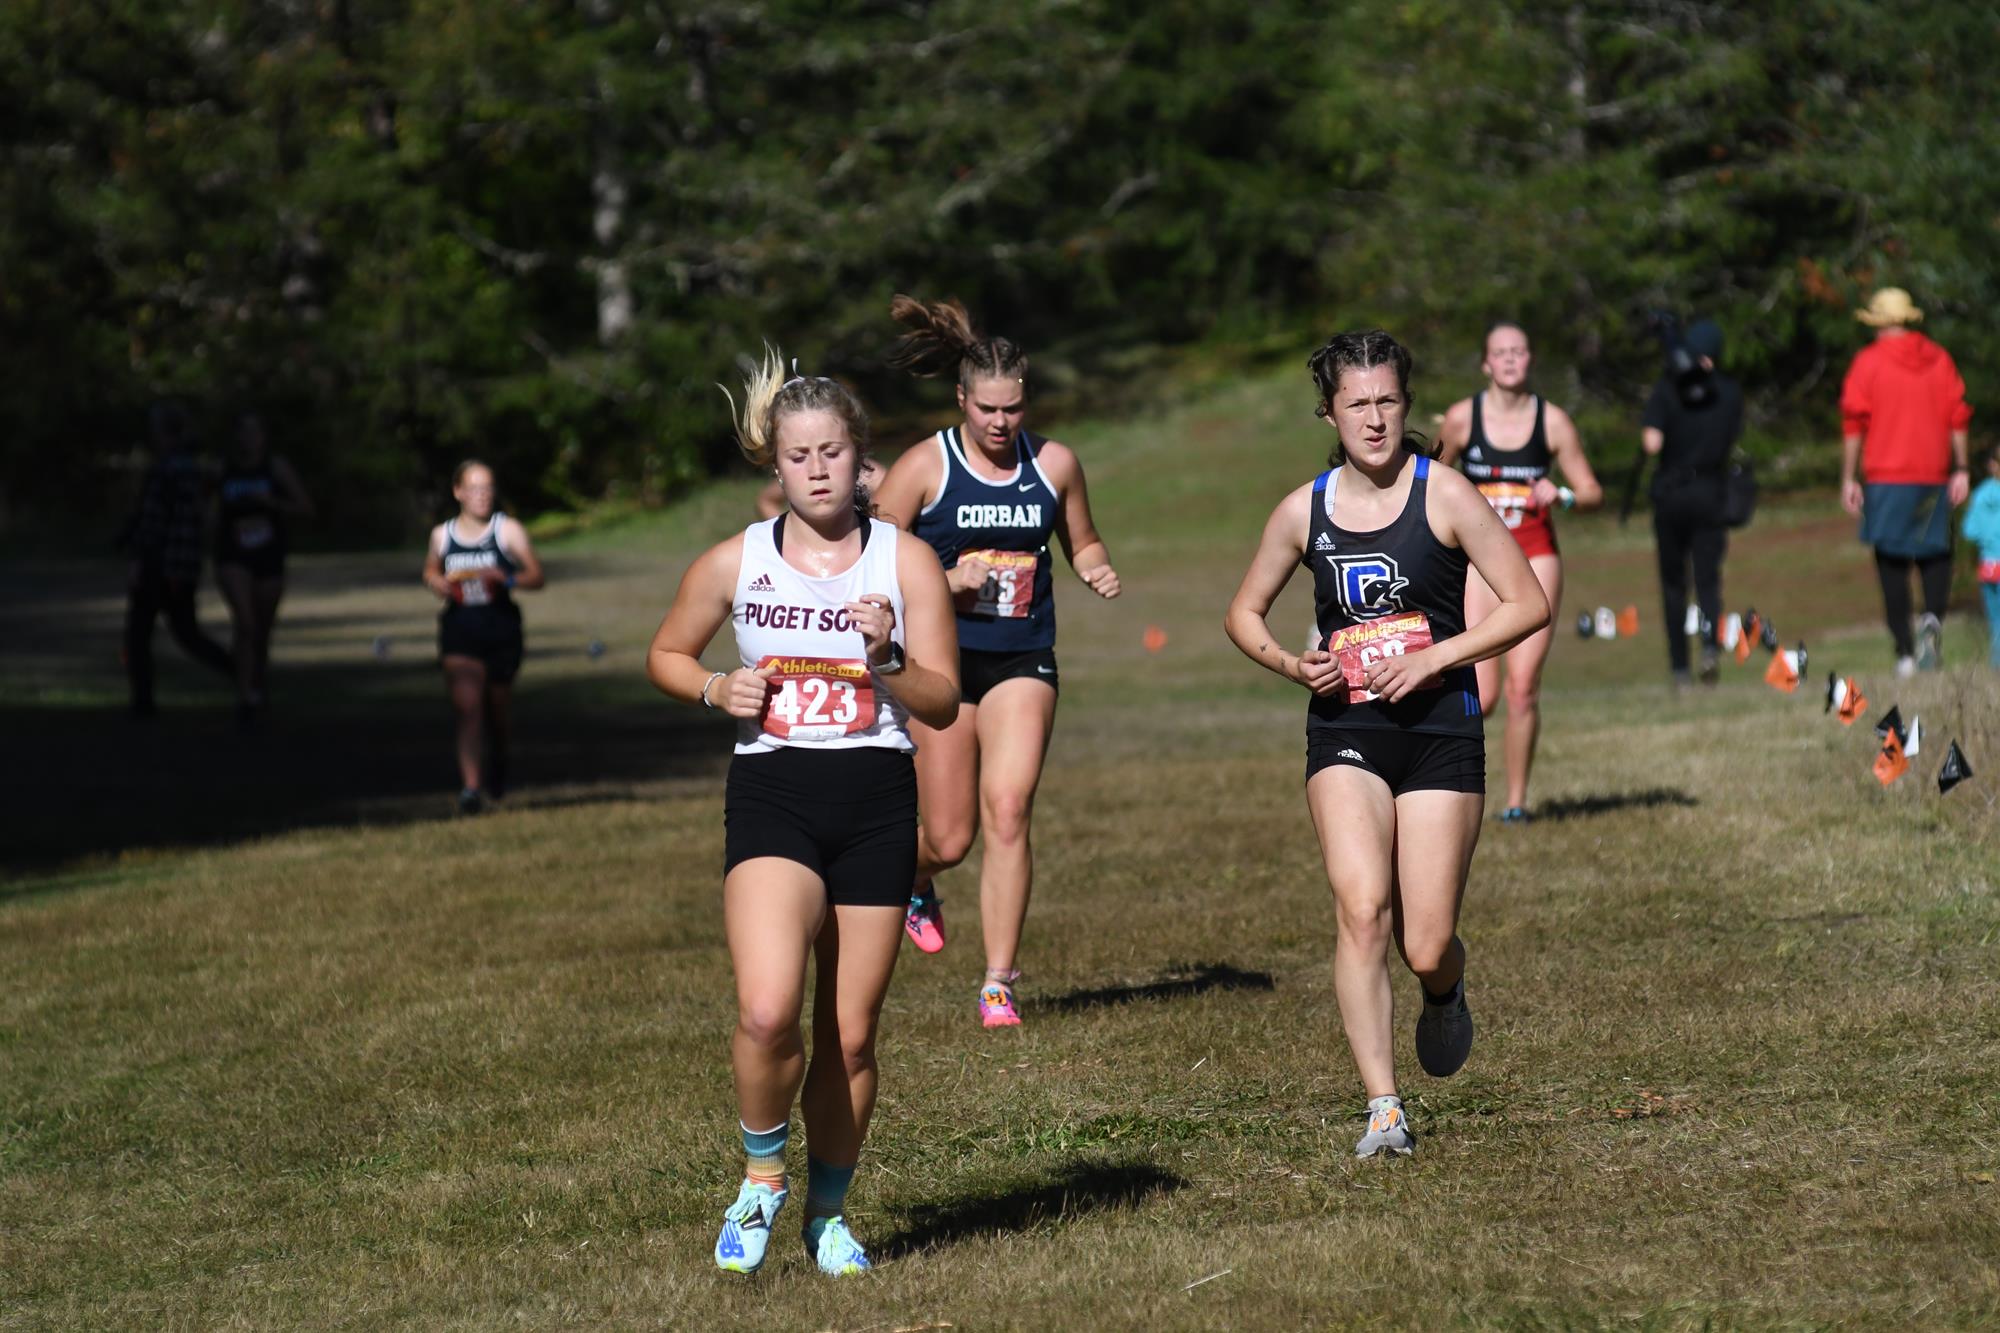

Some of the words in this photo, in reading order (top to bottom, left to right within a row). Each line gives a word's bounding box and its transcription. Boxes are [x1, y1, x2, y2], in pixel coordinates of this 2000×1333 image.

[957, 504, 1042, 528] CORBAN
[748, 584, 775, 592] adidas
[745, 602, 815, 630] PUGET
[774, 678, 858, 724] 423
